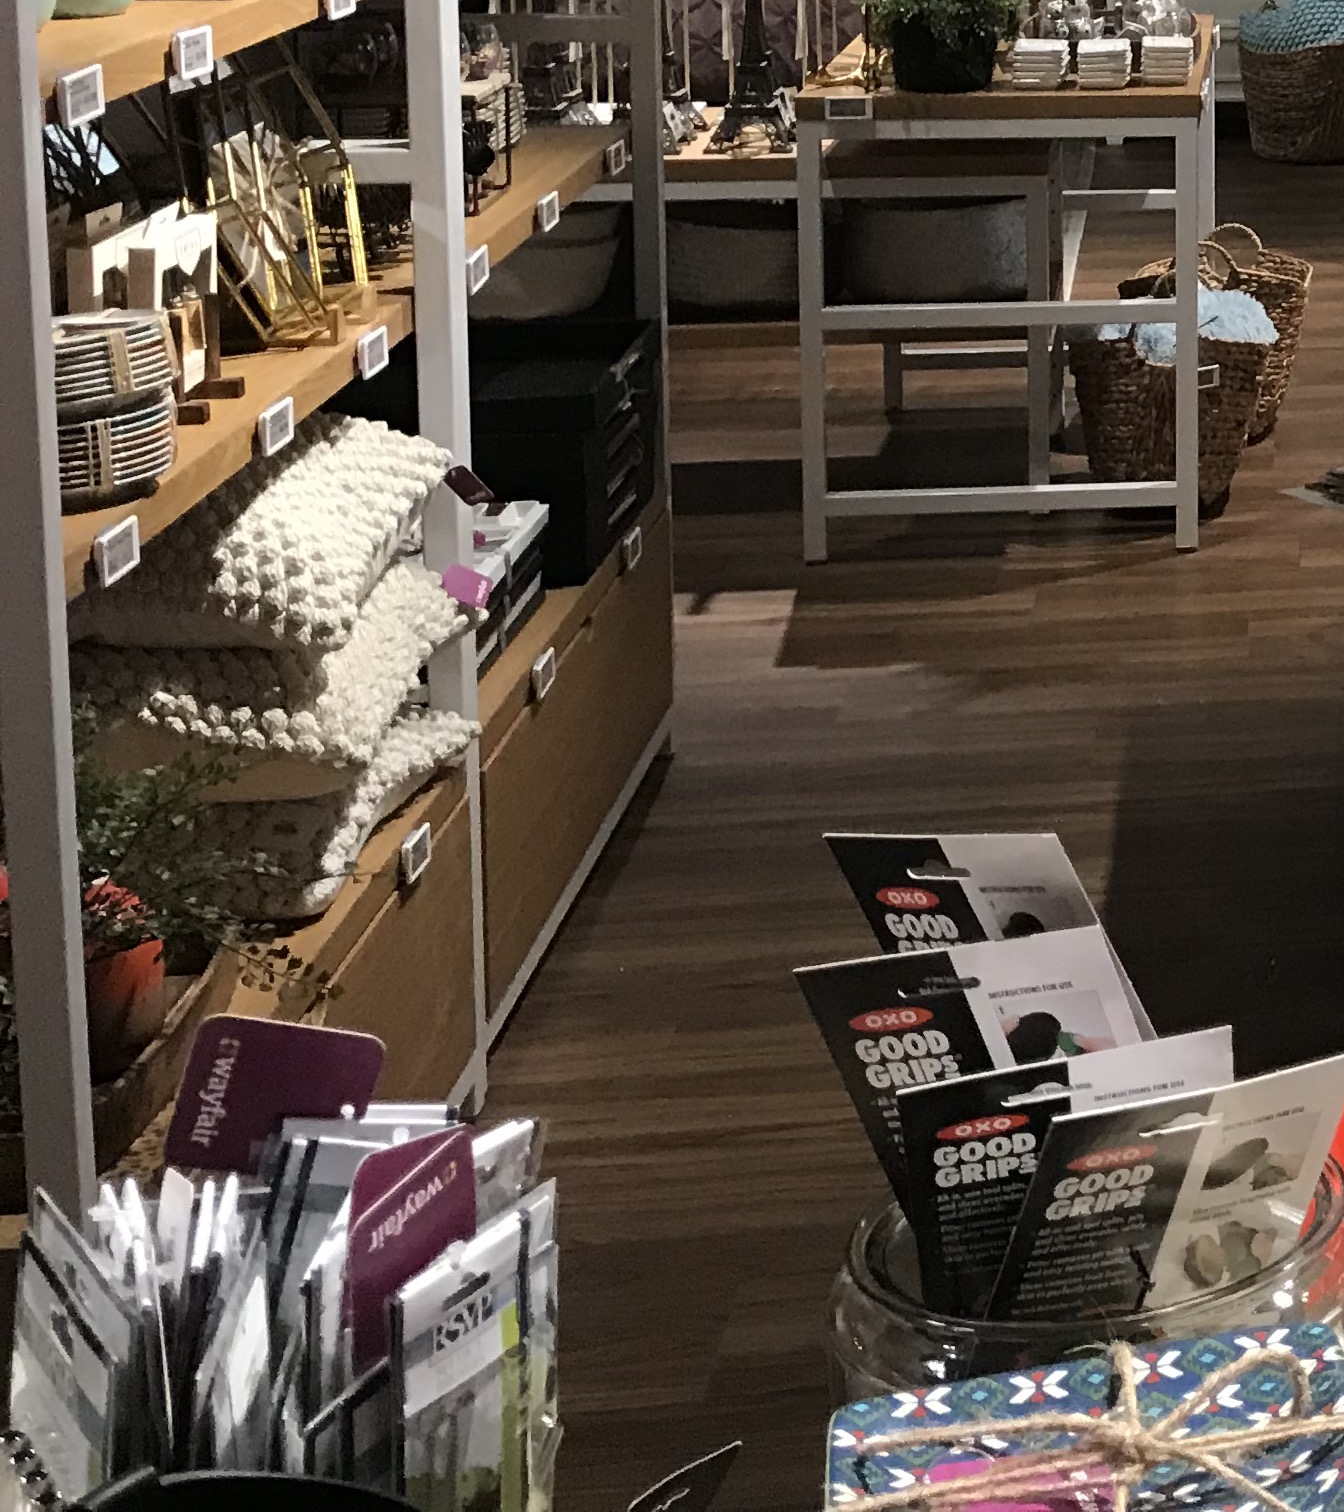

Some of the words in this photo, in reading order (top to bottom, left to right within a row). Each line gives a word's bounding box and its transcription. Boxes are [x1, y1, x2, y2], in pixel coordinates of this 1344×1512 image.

[887, 891, 927, 905] OXO
[885, 913, 959, 939] GOOD
[988, 984, 1042, 999] INSTRUCTIONS
[1042, 983, 1058, 992] FOR
[865, 1010, 917, 1028] OXO
[855, 1030, 950, 1063] GOOD
[865, 1054, 961, 1088] GRIPS
[191, 1057, 235, 1147] wayfair
[1094, 1087, 1152, 1102] INSTRUCTIONS
[1152, 1083, 1169, 1092] FOR
[954, 1117, 1011, 1136] OXO
[933, 1132, 1037, 1167] GOOD
[1085, 1149, 1141, 1167] OXO
[935, 1153, 1038, 1188] GRIPS
[1053, 1164, 1154, 1200] GOOD
[368, 1176, 443, 1252] wayfair
[1045, 1185, 1147, 1221] GRIPS
[432, 1291, 493, 1352] RSVP
